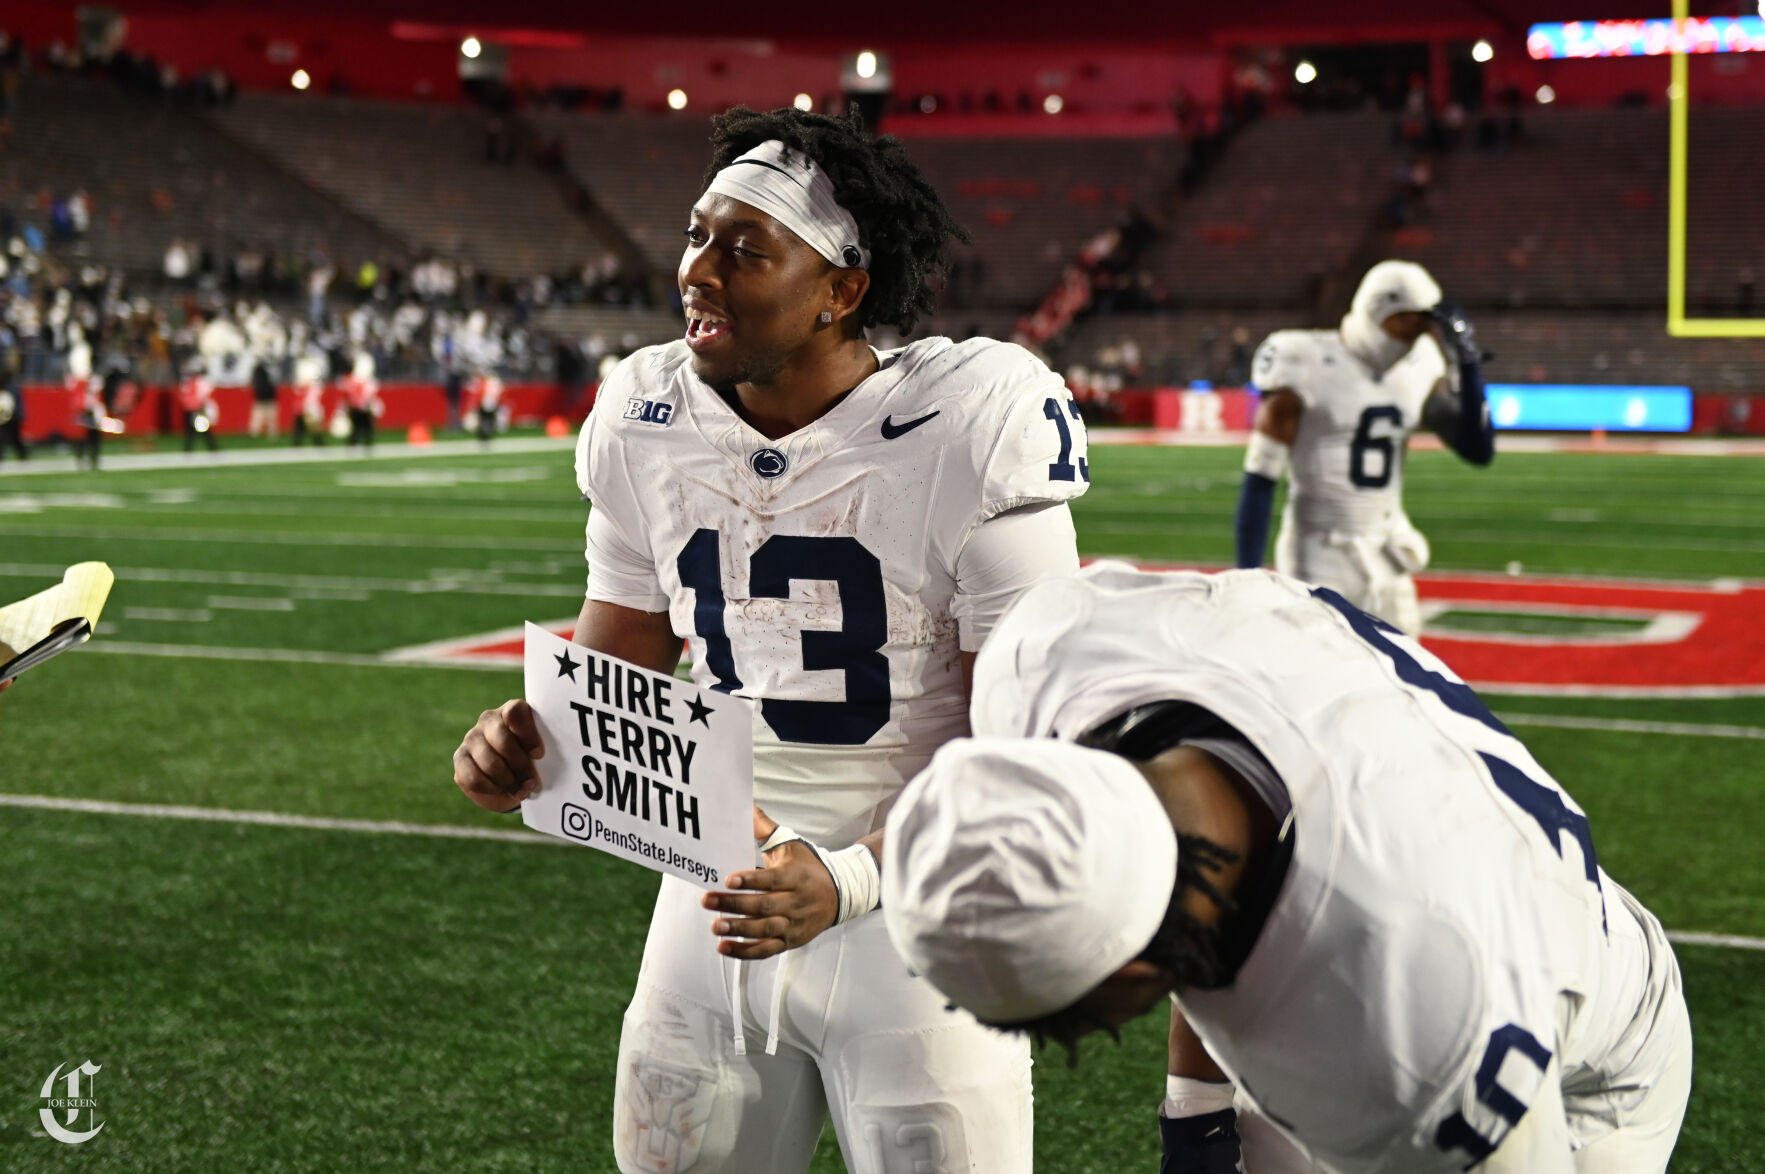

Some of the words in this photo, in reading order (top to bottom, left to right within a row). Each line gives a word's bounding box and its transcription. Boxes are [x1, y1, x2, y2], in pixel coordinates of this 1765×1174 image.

[1350, 405, 1403, 489] 6
[677, 527, 892, 745] 13
[586, 655, 675, 726] HIRE
[569, 701, 697, 785] TERRY
[581, 754, 701, 841] SMITH
[594, 819, 719, 884] PennStateJerseys
